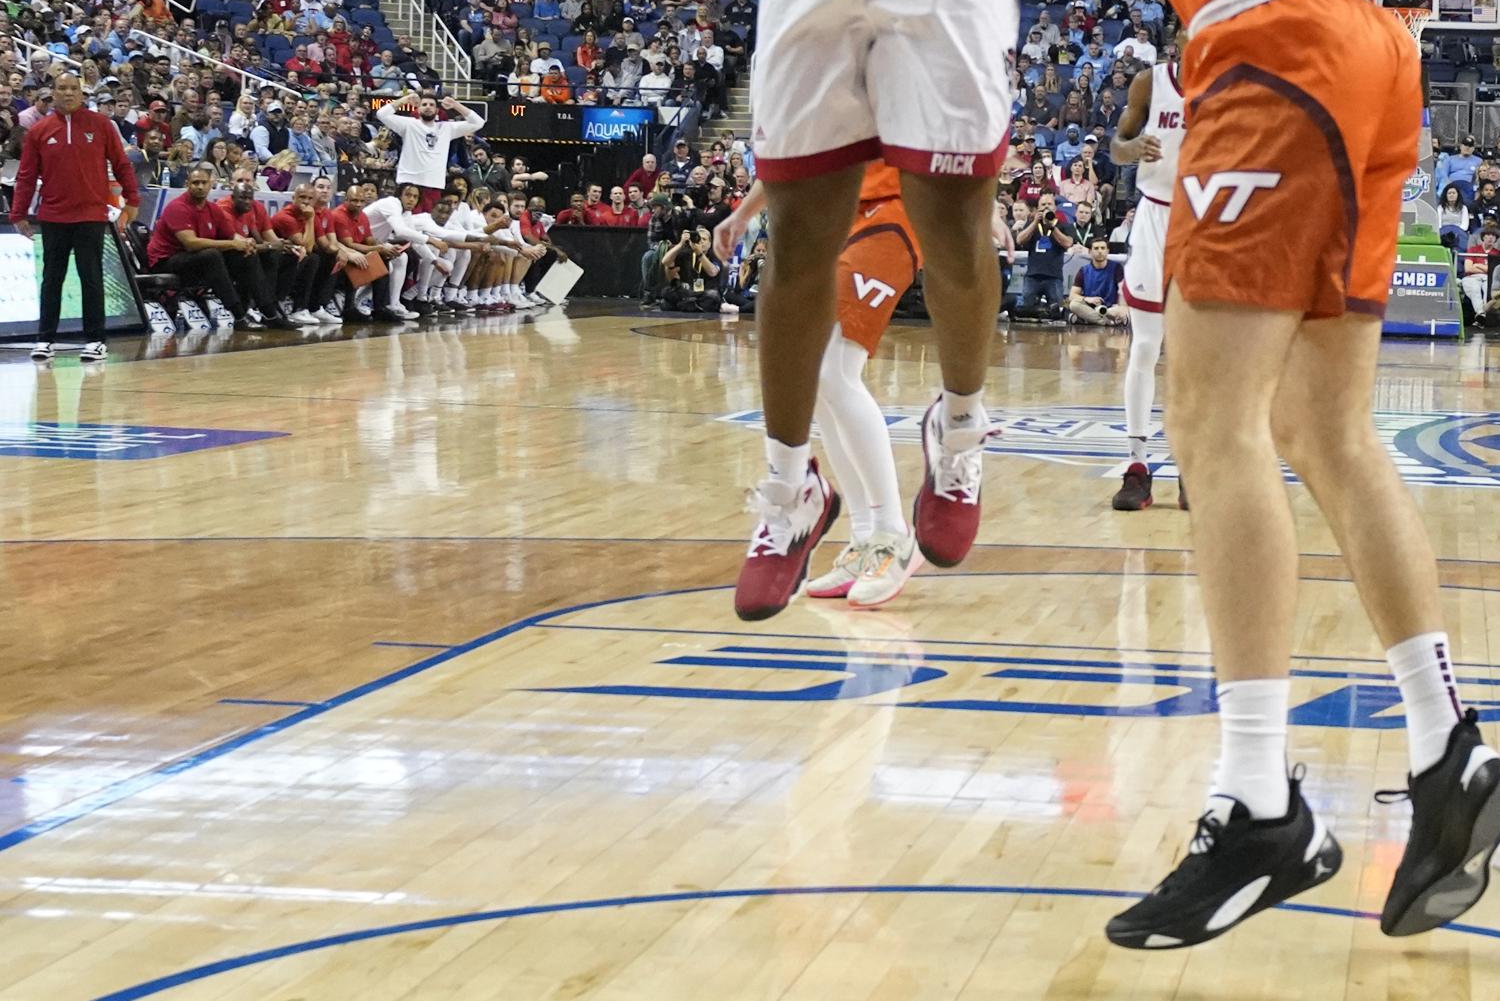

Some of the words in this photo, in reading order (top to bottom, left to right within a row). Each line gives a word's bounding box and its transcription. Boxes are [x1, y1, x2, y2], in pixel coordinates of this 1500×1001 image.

[511, 105, 526, 117] VT
[1158, 111, 1180, 129] NC
[586, 120, 641, 140] AQUAFIN
[930, 152, 975, 175] PACK
[1183, 171, 1282, 223] VT
[852, 272, 897, 309] VT
